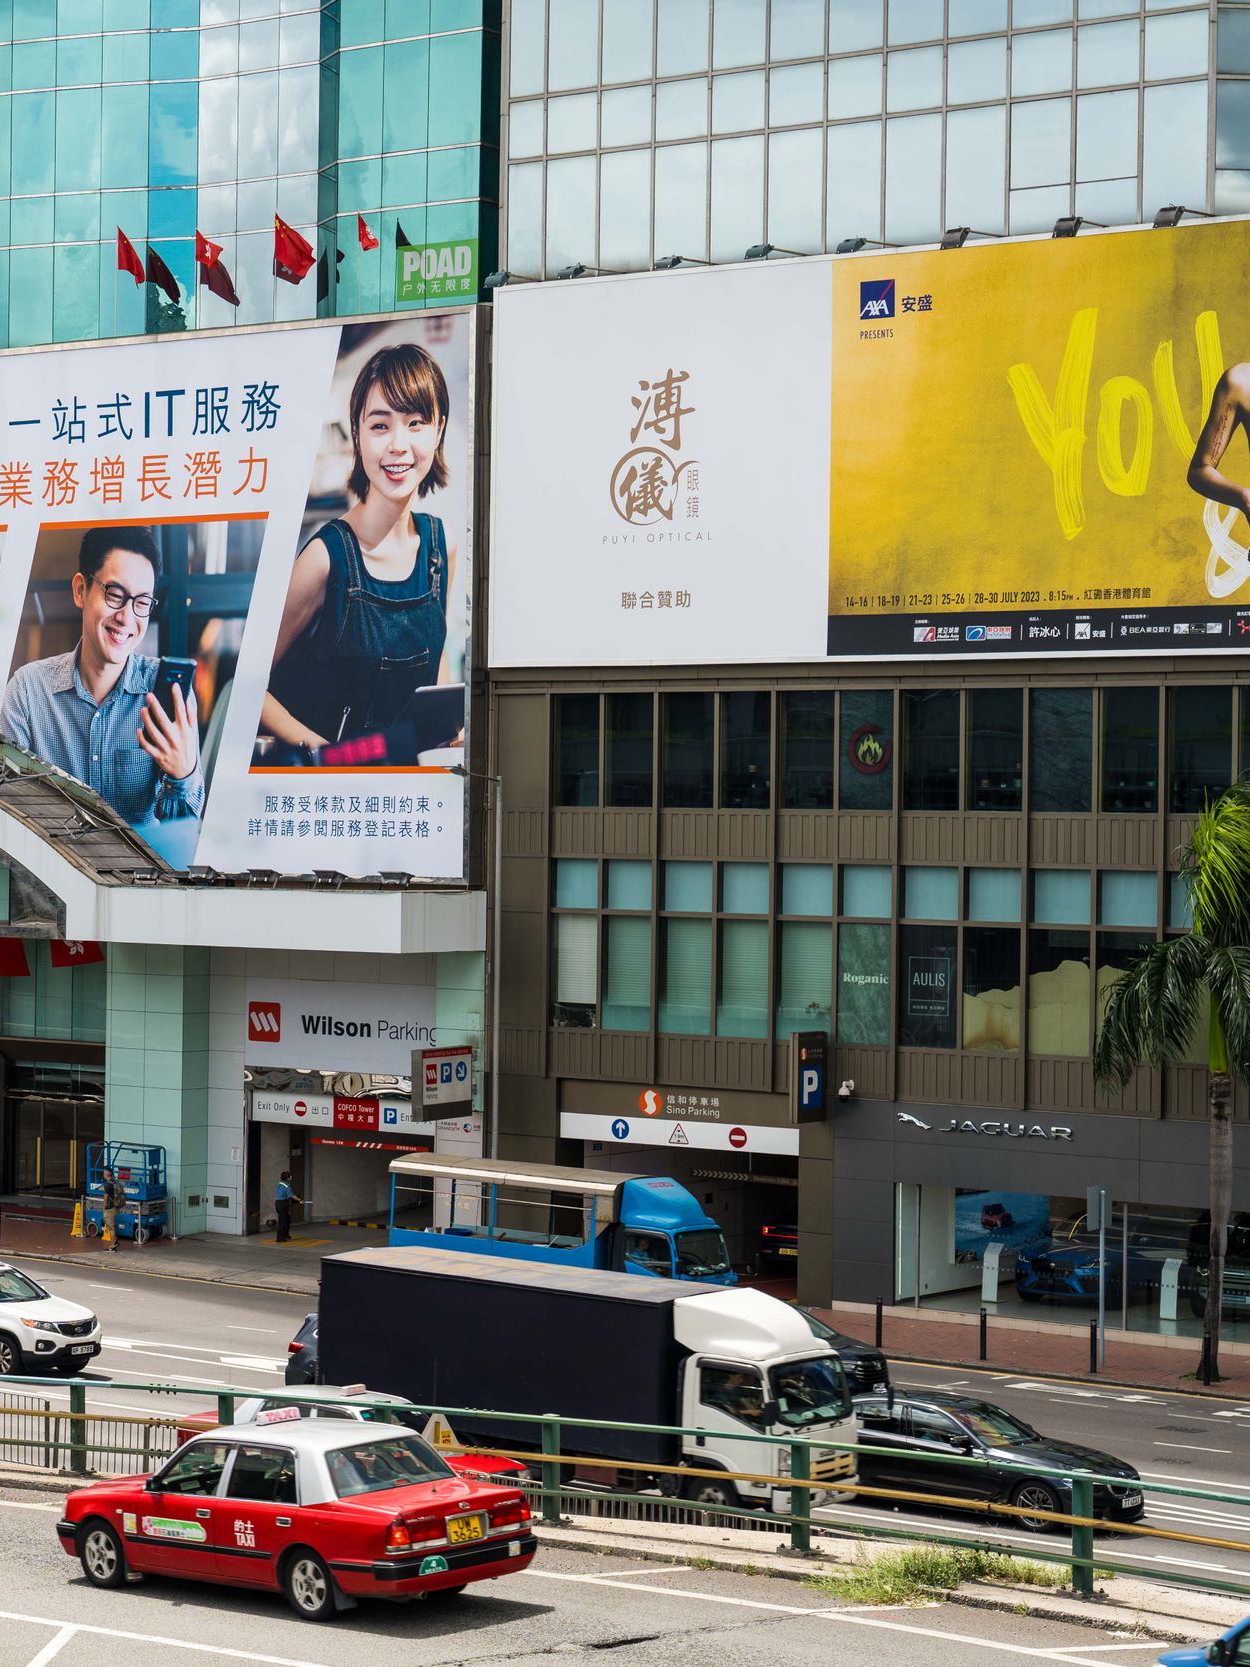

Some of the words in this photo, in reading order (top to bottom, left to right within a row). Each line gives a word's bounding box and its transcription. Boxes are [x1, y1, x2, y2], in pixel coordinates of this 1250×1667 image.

[403, 246, 472, 282] POAD
[860, 298, 889, 317] AXA
[901, 294, 933, 313] 安盛
[859, 328, 894, 340] PRESENTS
[8, 380, 282, 444] 一站式IT服務
[686, 469, 700, 518] 眼鏡
[602, 534, 636, 545] PUYI
[646, 531, 713, 543] OPTICAL
[845, 596, 868, 608] 14-16
[877, 595, 900, 607] 18-19
[909, 594, 933, 606] 21-23
[941, 593, 965, 605] 25-26
[974, 592, 998, 604] 28-30
[1000, 592, 1018, 604] JULY
[1020, 591, 1040, 603] 2023
[264, 795, 443, 814] 服務受條款及細則約束。
[248, 818, 442, 838] 詳情請參閱服務登記表格。
[843, 972, 889, 985] Roganic
[912, 972, 946, 987] AULIS
[301, 1014, 371, 1038] Wilson
[803, 1070, 819, 1104] P
[257, 1101, 272, 1111] Exit
[273, 1102, 290, 1113] Only
[312, 1105, 329, 1115] 出口
[337, 1103, 356, 1112] COFCO
[358, 1105, 375, 1114] Tower
[666, 1094, 720, 1108] 信和停車場
[666, 1105, 686, 1115] Sino
[687, 1105, 720, 1118] Parking
[939, 1119, 1075, 1141] JAGUAR
[234, 1519, 255, 1534] 的士
[453, 1527, 480, 1542] 3625
[234, 1532, 256, 1548] TAXI
